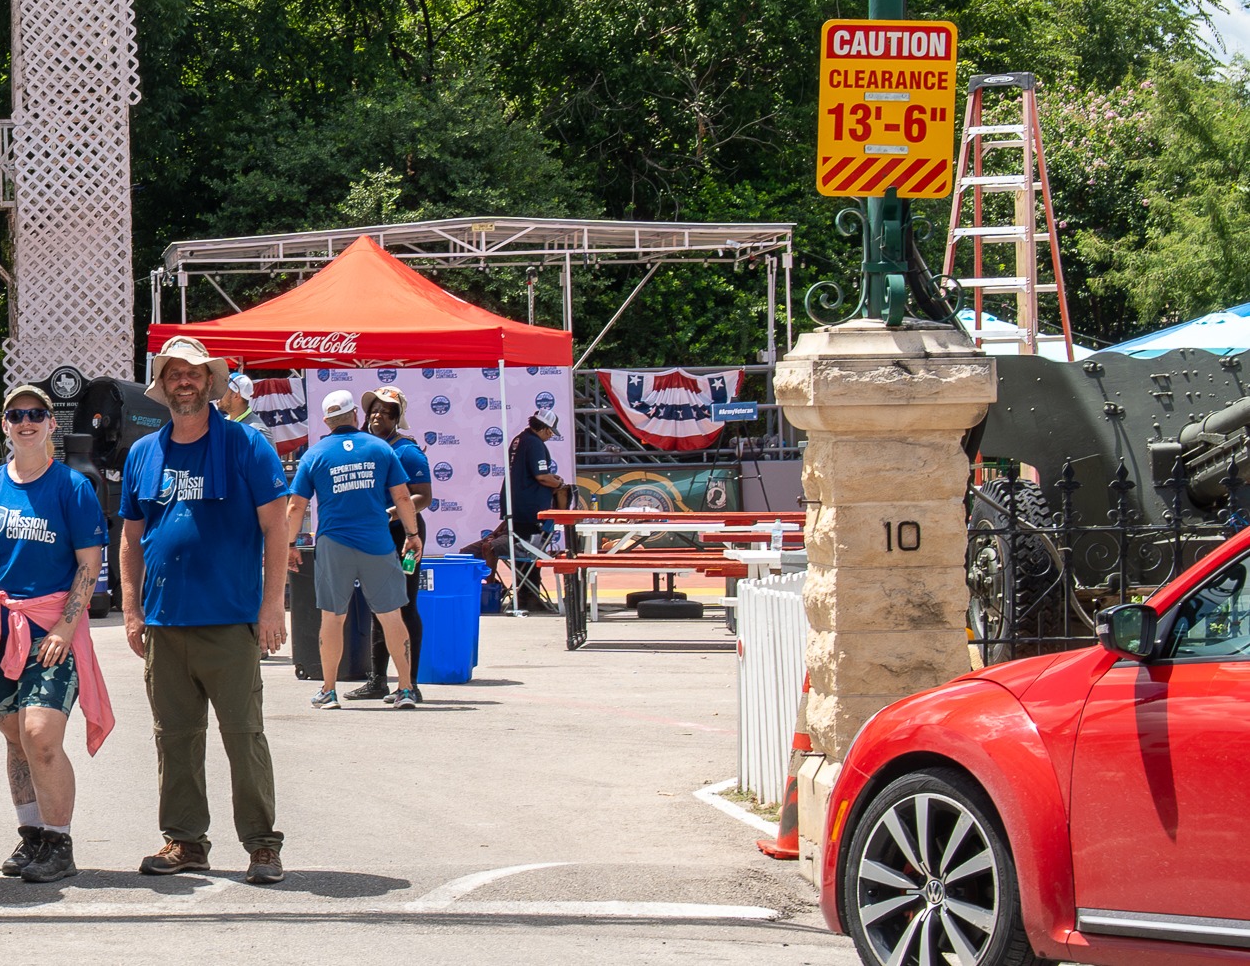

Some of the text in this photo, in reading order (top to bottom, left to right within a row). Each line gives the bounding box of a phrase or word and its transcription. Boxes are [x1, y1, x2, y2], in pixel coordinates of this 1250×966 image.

[833, 29, 947, 57] CAUTION
[829, 68, 949, 91] CLEARANCE
[827, 102, 947, 143] 13'-6"
[285, 331, 361, 354] Coca-Cola
[178, 469, 190, 478] THE
[330, 461, 376, 476] REPORTING FOR
[178, 476, 204, 490] MISSI
[333, 473, 348, 484] DUTY
[357, 470, 374, 479] YOUR
[176, 487, 204, 501] CONTI
[332, 479, 376, 494] COMMUNITY
[7, 515, 48, 531] MISSION
[6, 526, 57, 544] CONTINUES
[883, 520, 921, 552] 10
